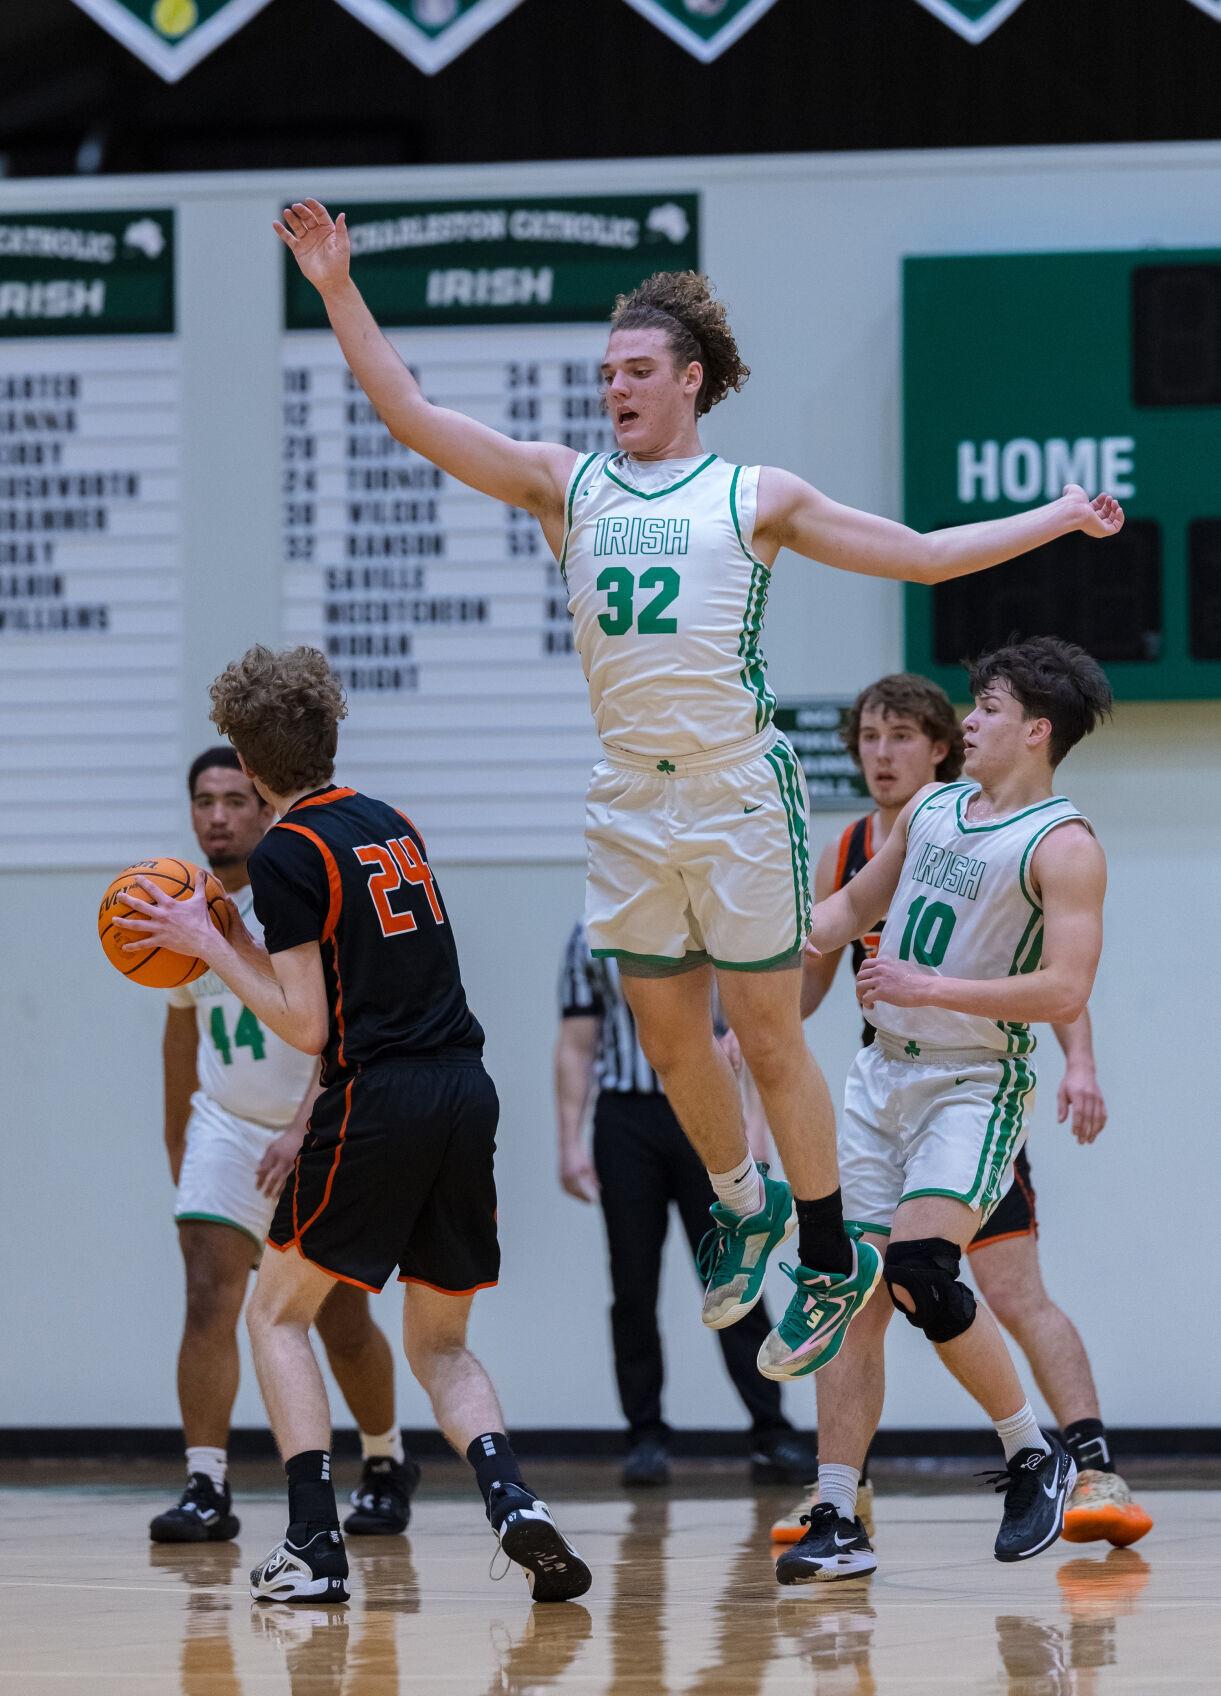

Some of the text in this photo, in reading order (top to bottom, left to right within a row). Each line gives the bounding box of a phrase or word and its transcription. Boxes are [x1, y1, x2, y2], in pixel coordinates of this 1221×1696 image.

[0, 225, 115, 264] ATHOLIC
[349, 209, 640, 258] CHARLESTON CATHOLIC
[0, 279, 105, 318] RISH
[425, 266, 554, 306] IRISH
[0, 374, 80, 400] ARTER
[957, 436, 1135, 502] HOME
[593, 516, 691, 557] IRISH
[596, 566, 681, 636] 32
[352, 835, 444, 937] 24
[911, 842, 986, 901] IRISH
[898, 895, 957, 968] 10
